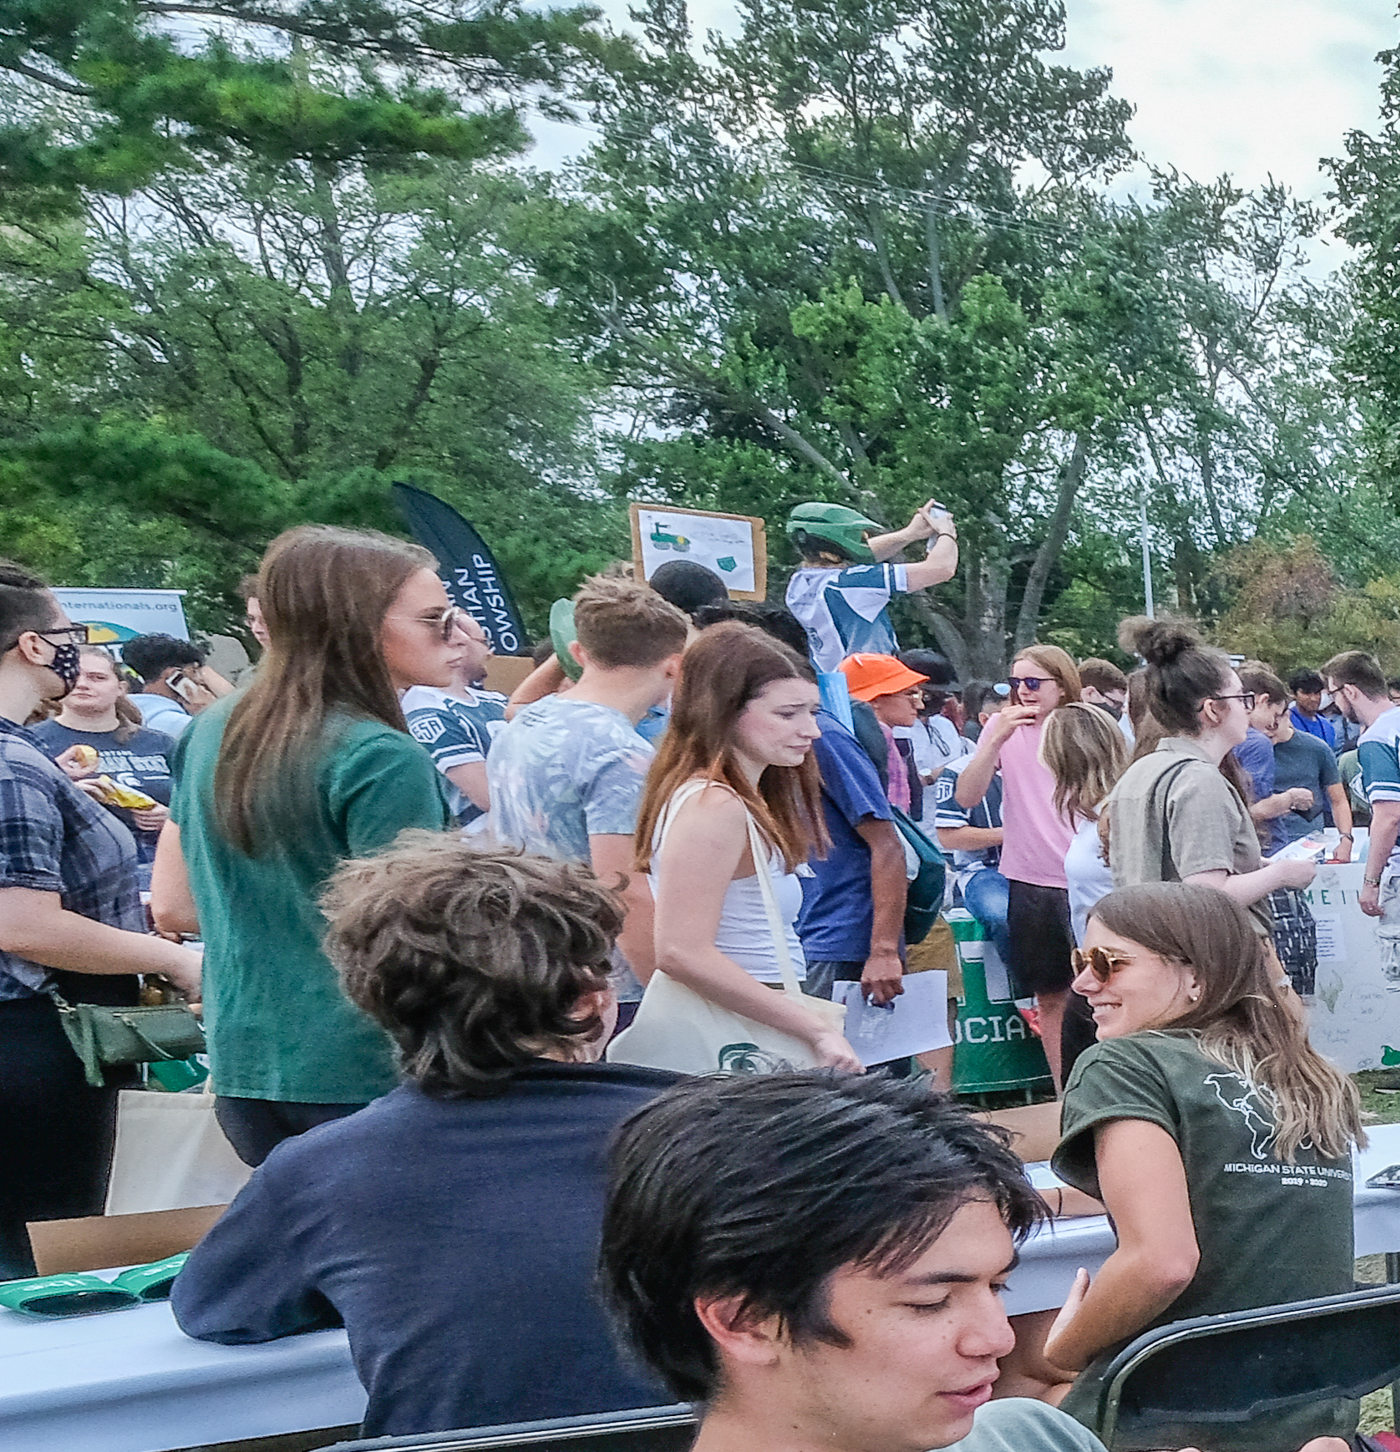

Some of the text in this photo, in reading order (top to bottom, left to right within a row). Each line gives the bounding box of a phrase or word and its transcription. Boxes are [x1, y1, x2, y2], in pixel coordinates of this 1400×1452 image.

[61, 600, 178, 612] nternationals.org
[1223, 1162, 1280, 1174] MICHIGAN
[1281, 1166, 1316, 1175] STATE
